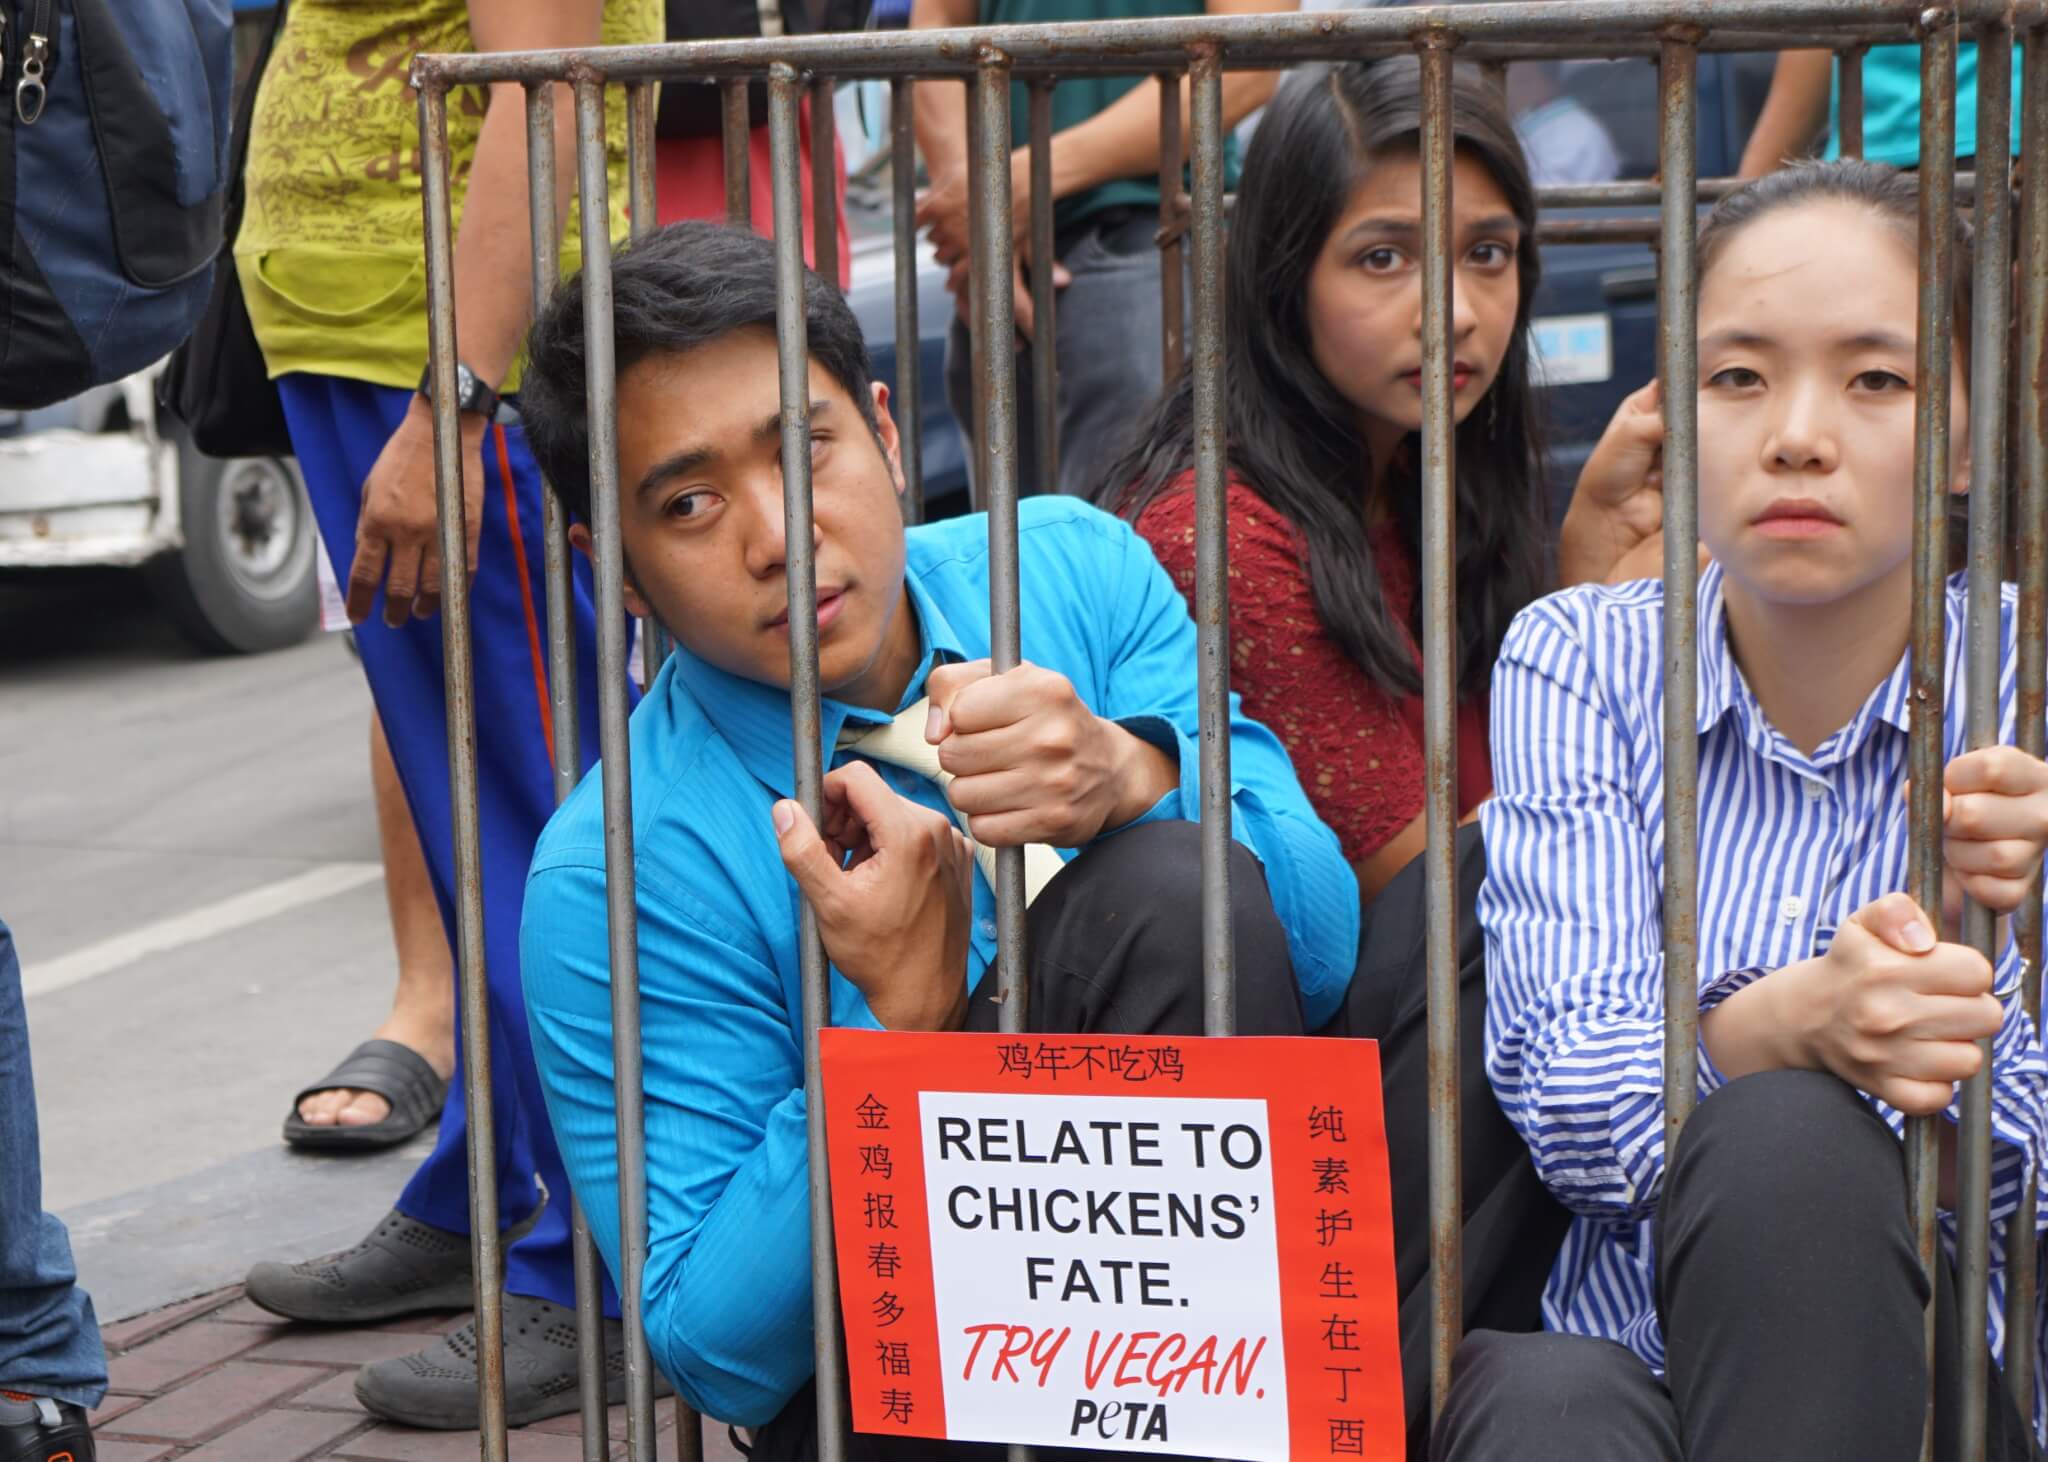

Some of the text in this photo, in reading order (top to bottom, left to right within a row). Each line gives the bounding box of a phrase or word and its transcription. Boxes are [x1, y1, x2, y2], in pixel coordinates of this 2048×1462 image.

[997, 1043, 1184, 1083] 鸡年不吃鸡
[937, 1117, 1262, 1169] RELATE TO
[948, 1185, 1260, 1239] CHICKENS’
[855, 1093, 913, 1424] 金鸡报春多福寿
[1026, 1257, 1189, 1307] FATE.
[1307, 1105, 1364, 1457] 纯素护生在丁酉
[962, 1324, 1267, 1399] TRY VEGAN.
